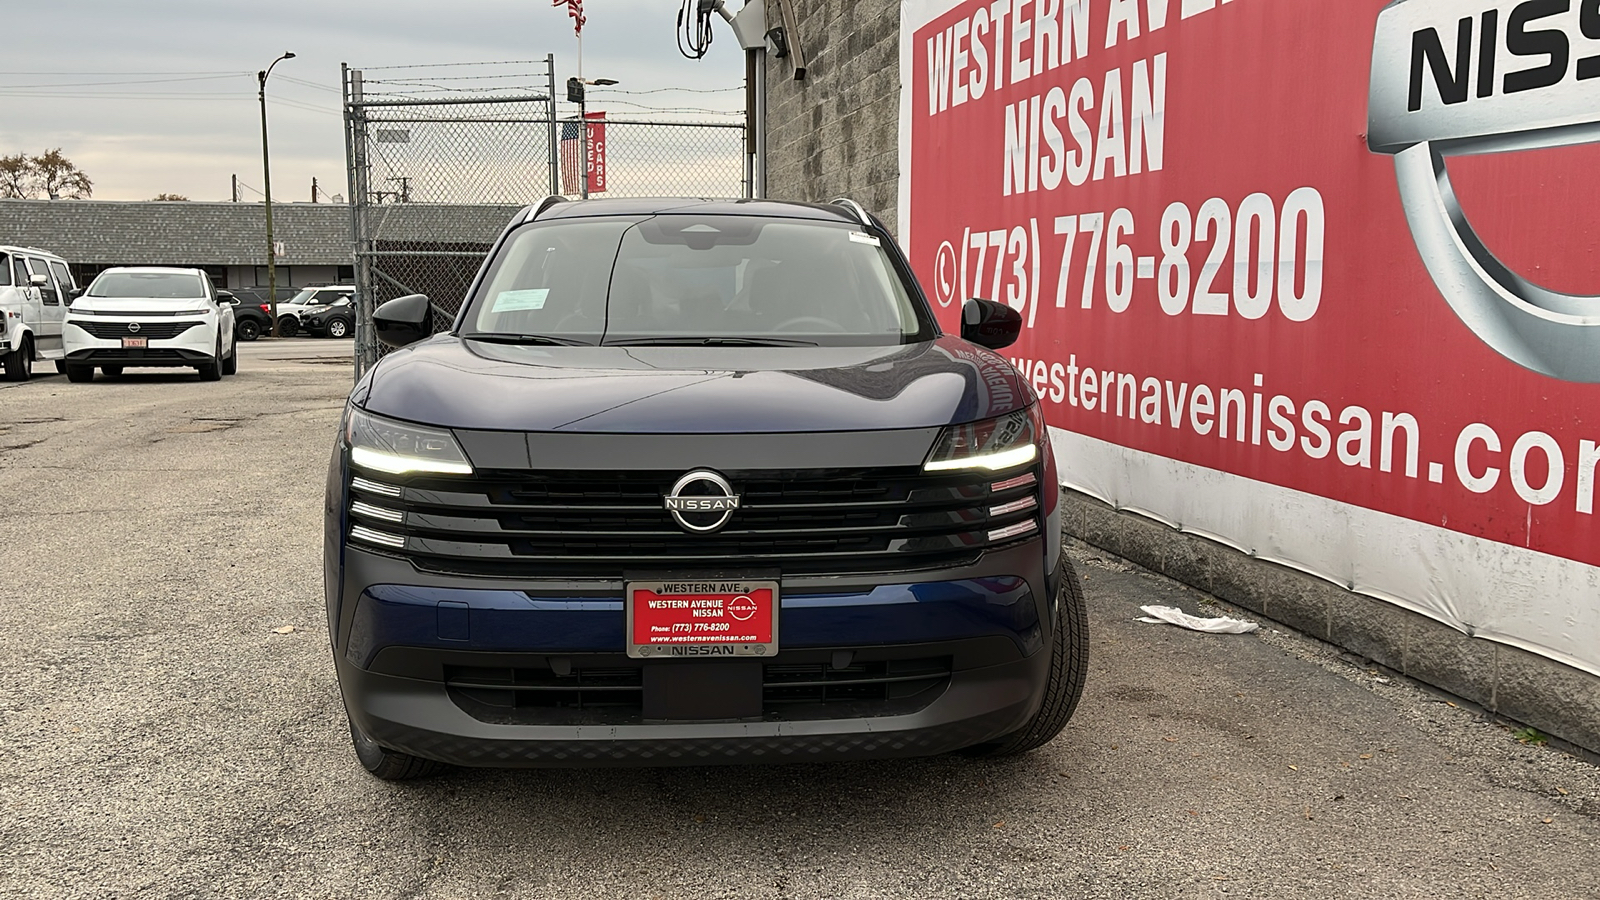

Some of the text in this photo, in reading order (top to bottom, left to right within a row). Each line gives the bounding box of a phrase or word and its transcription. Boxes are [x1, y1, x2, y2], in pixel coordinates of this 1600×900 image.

[927, 0, 1088, 116] WESTERN
[1003, 51, 1167, 197] NISSAN
[960, 186, 1324, 328] (773) 776-8200
[666, 498, 738, 509] NISSAN
[663, 583, 743, 593] WESTERN AVE.
[648, 599, 724, 609] WESTERN AVENUE
[692, 609, 724, 618] NISSAN
[650, 622, 730, 633] Phone: (773) 776-8200
[650, 634, 757, 642] www.westernavenissan.com
[671, 645, 735, 656] NISSAN
